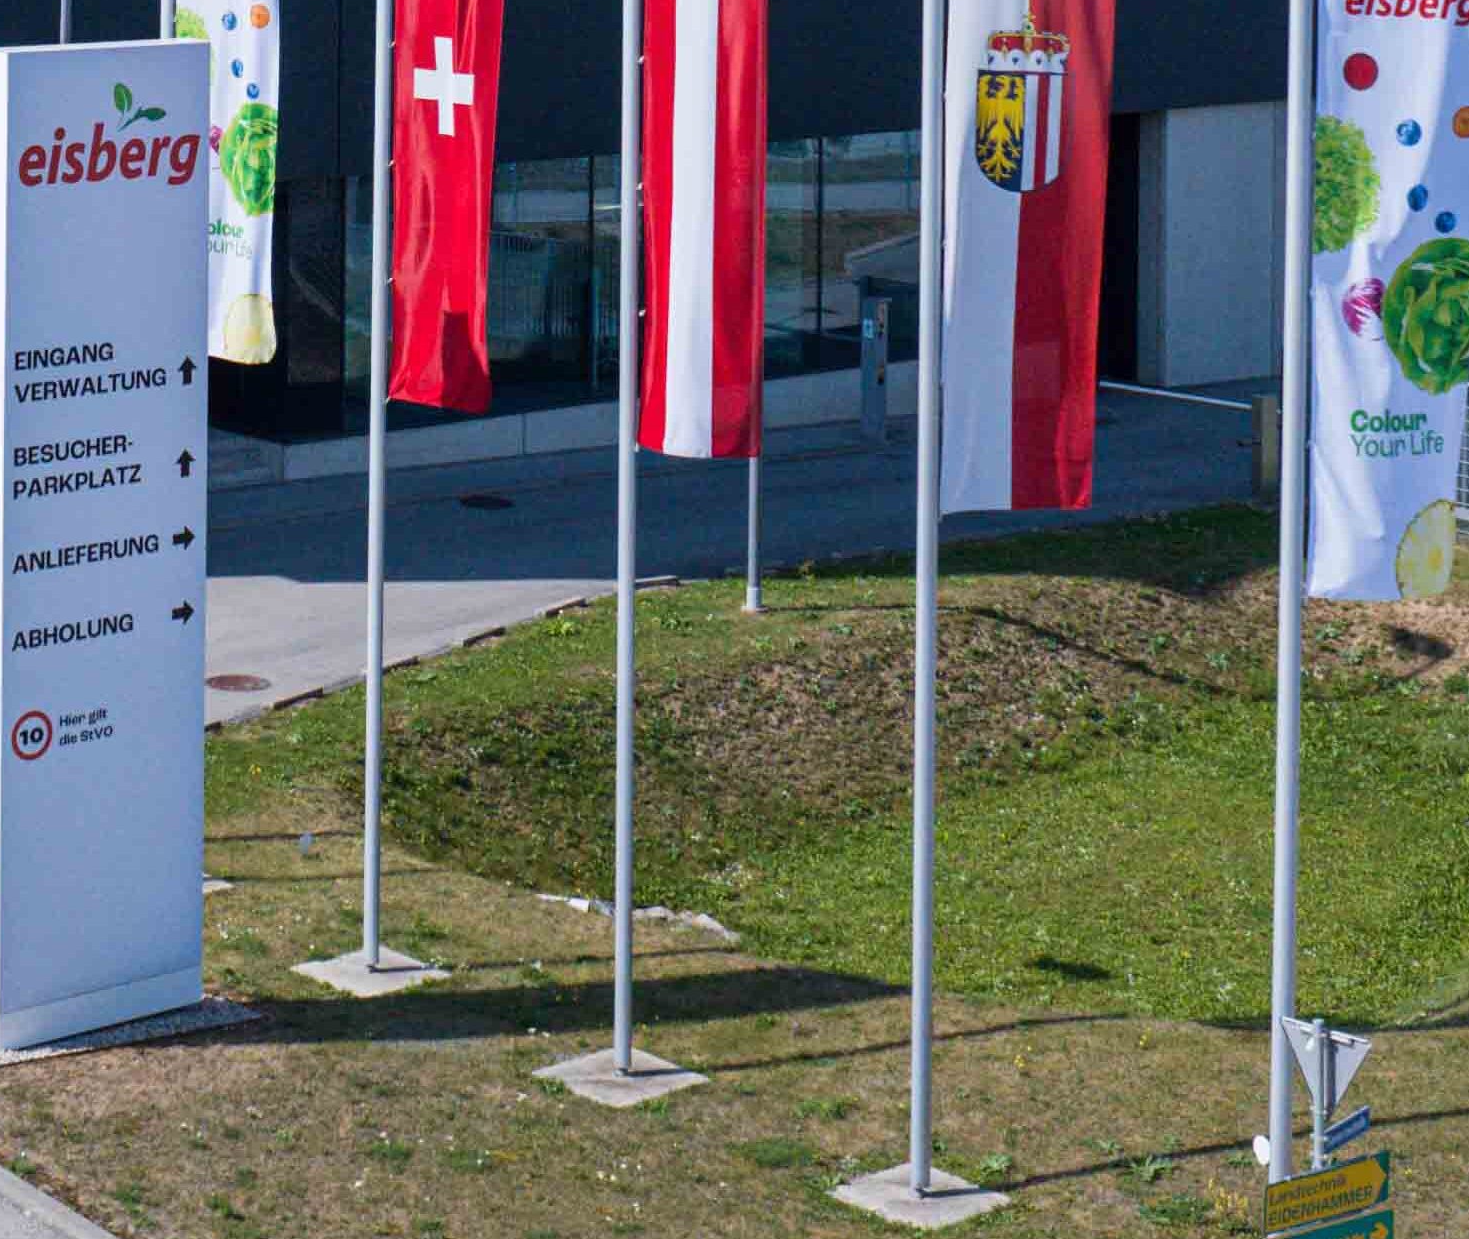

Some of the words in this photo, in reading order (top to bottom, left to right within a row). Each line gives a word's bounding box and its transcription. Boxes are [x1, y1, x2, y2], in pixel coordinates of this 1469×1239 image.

[18, 122, 201, 187] eisberg
[14, 342, 115, 371] EINGANG
[14, 367, 167, 403] VERWALTUNG
[1350, 409, 1427, 433] Colour
[13, 435, 134, 466] BESUCHER-
[1350, 434, 1406, 457] Your
[1411, 429, 1444, 456] Life
[13, 464, 143, 499] PARKPLATZ
[12, 534, 160, 574] ANLIEFERUNG
[11, 614, 134, 652] ABHOLUNG
[59, 713, 86, 727] Hier
[88, 708, 108, 725] gilt
[19, 727, 44, 746] 10
[59, 733, 78, 746] die
[80, 725, 113, 743] StVO
